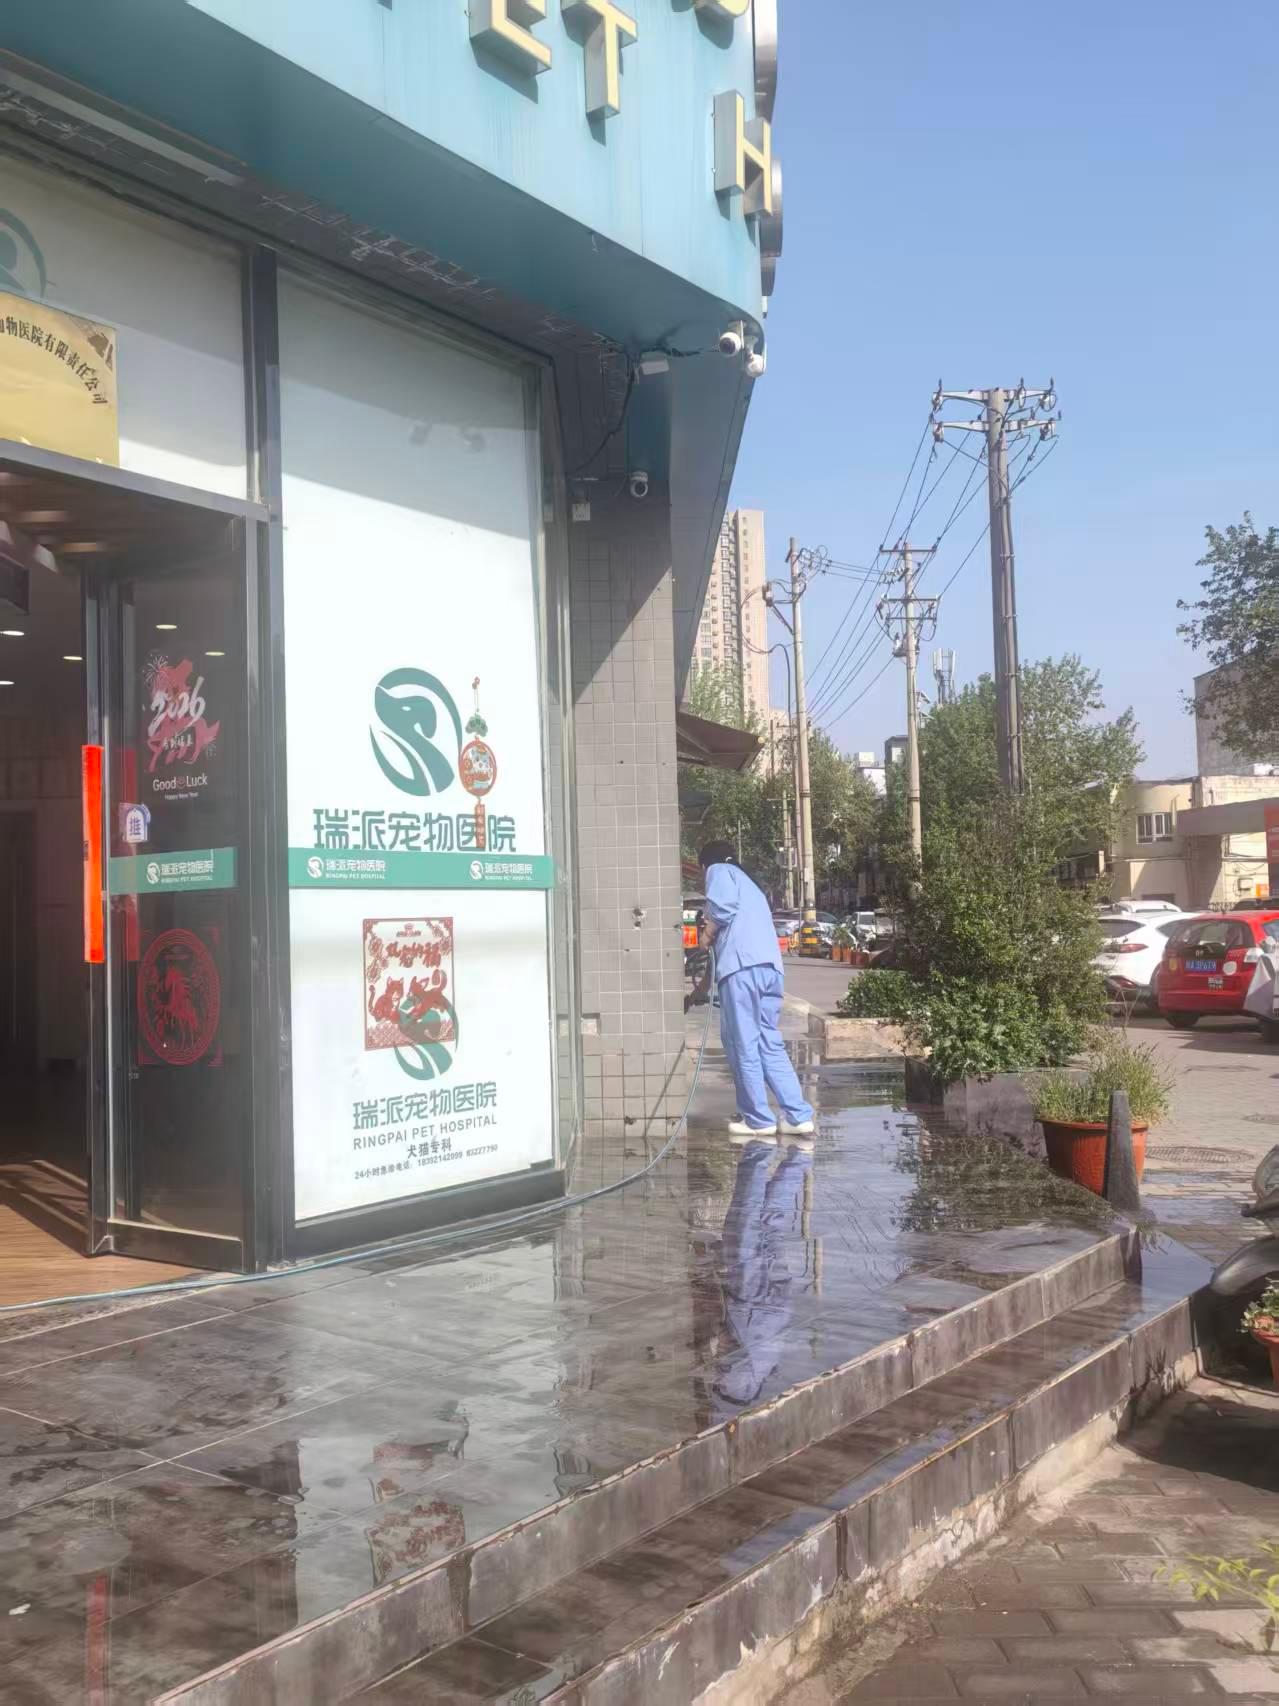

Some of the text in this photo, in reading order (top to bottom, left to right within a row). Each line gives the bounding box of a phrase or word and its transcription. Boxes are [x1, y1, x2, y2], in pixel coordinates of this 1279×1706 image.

[0, 316, 108, 404] 物医院有限责任公司
[147, 676, 206, 738] 2026
[153, 772, 208, 791] Good Luck
[312, 807, 517, 853] 瑞派宠物医院
[352, 1081, 497, 1130] 瑞派宠物医院
[353, 1113, 498, 1151] RINGPAI PET HOSPITAL
[407, 1137, 452, 1159] 犬猫专科
